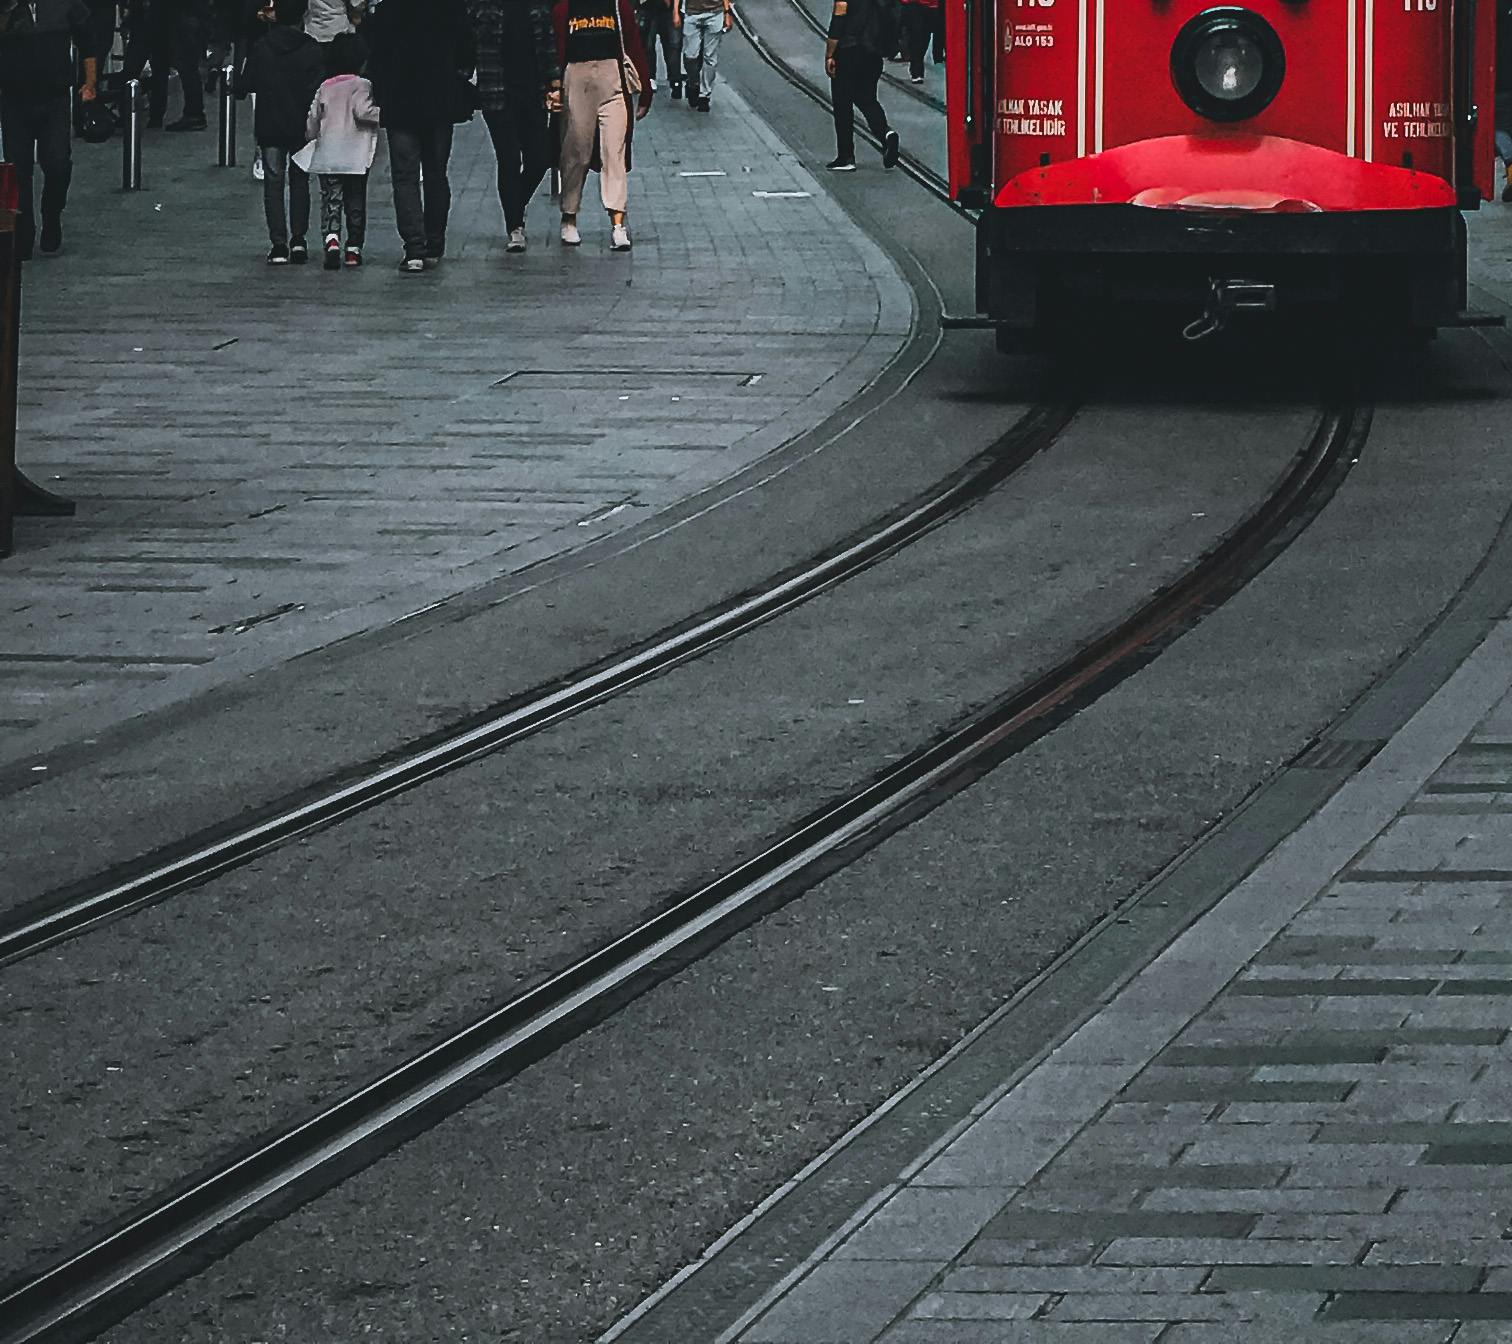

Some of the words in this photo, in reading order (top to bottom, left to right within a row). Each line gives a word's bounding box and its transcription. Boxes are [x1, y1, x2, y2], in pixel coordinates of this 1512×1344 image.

[1014, 35, 1033, 47] ALO
[1035, 35, 1054, 47] 153
[1027, 98, 1063, 116] YASAK
[1383, 121, 1399, 138] VE
